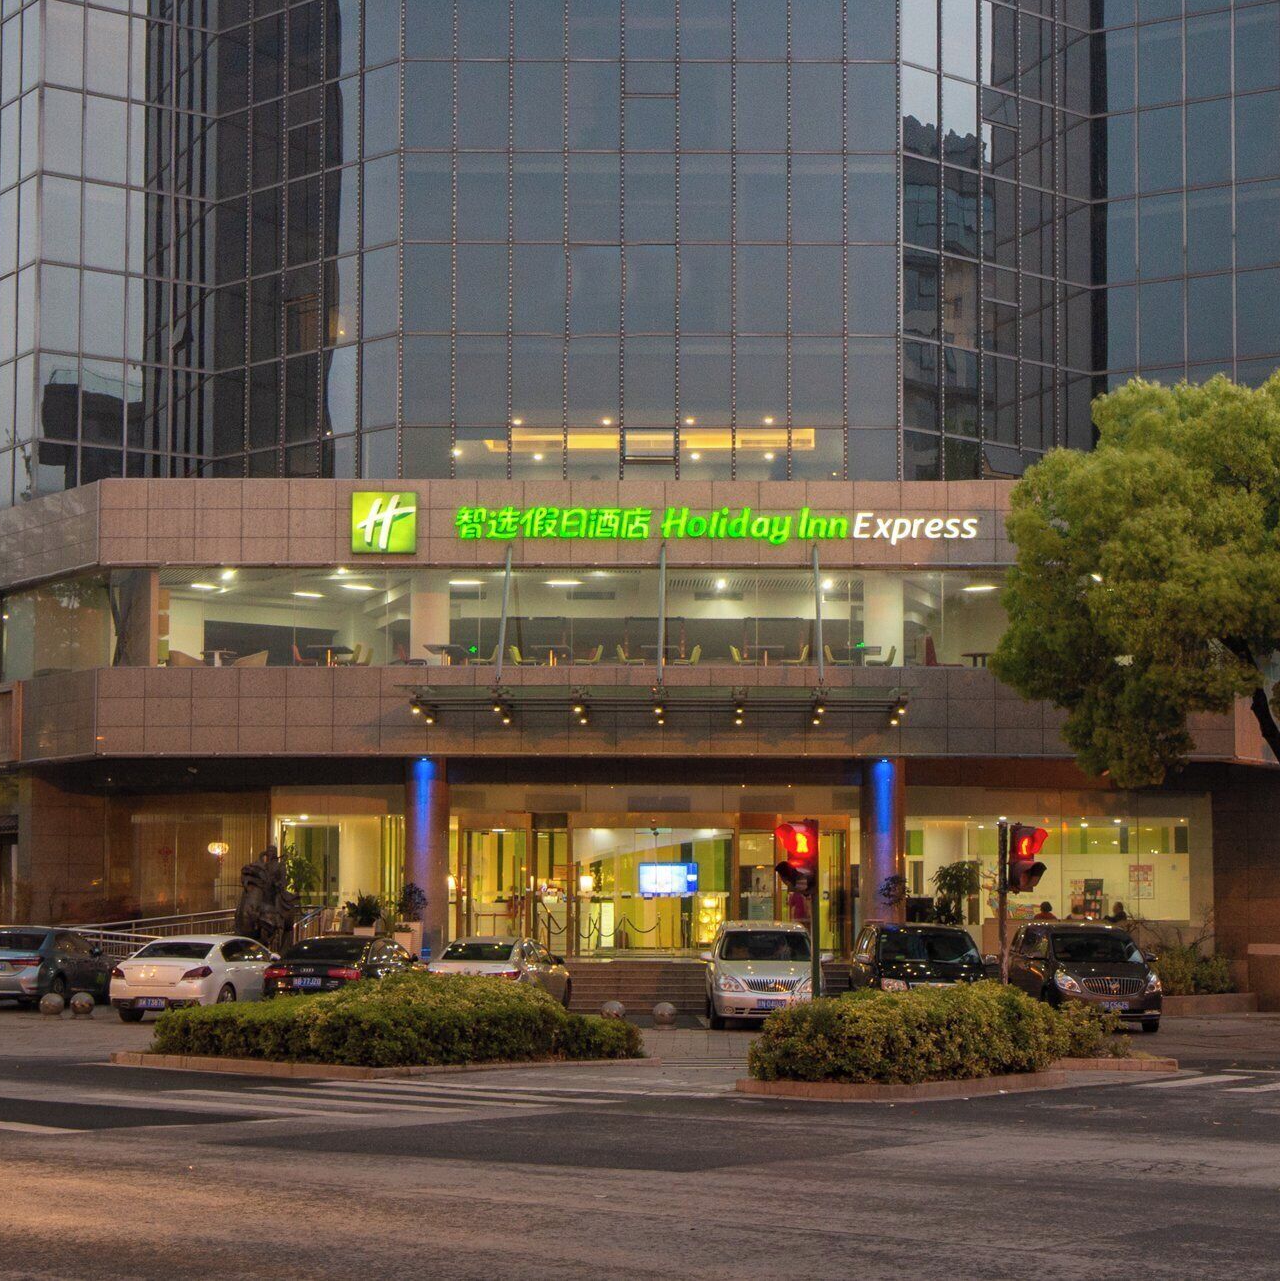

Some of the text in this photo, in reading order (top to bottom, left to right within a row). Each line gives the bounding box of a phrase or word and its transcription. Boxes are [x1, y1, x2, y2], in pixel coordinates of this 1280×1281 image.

[456, 506, 651, 539] 智选假日酒店
[661, 507, 978, 545] Holiday Inn Express
